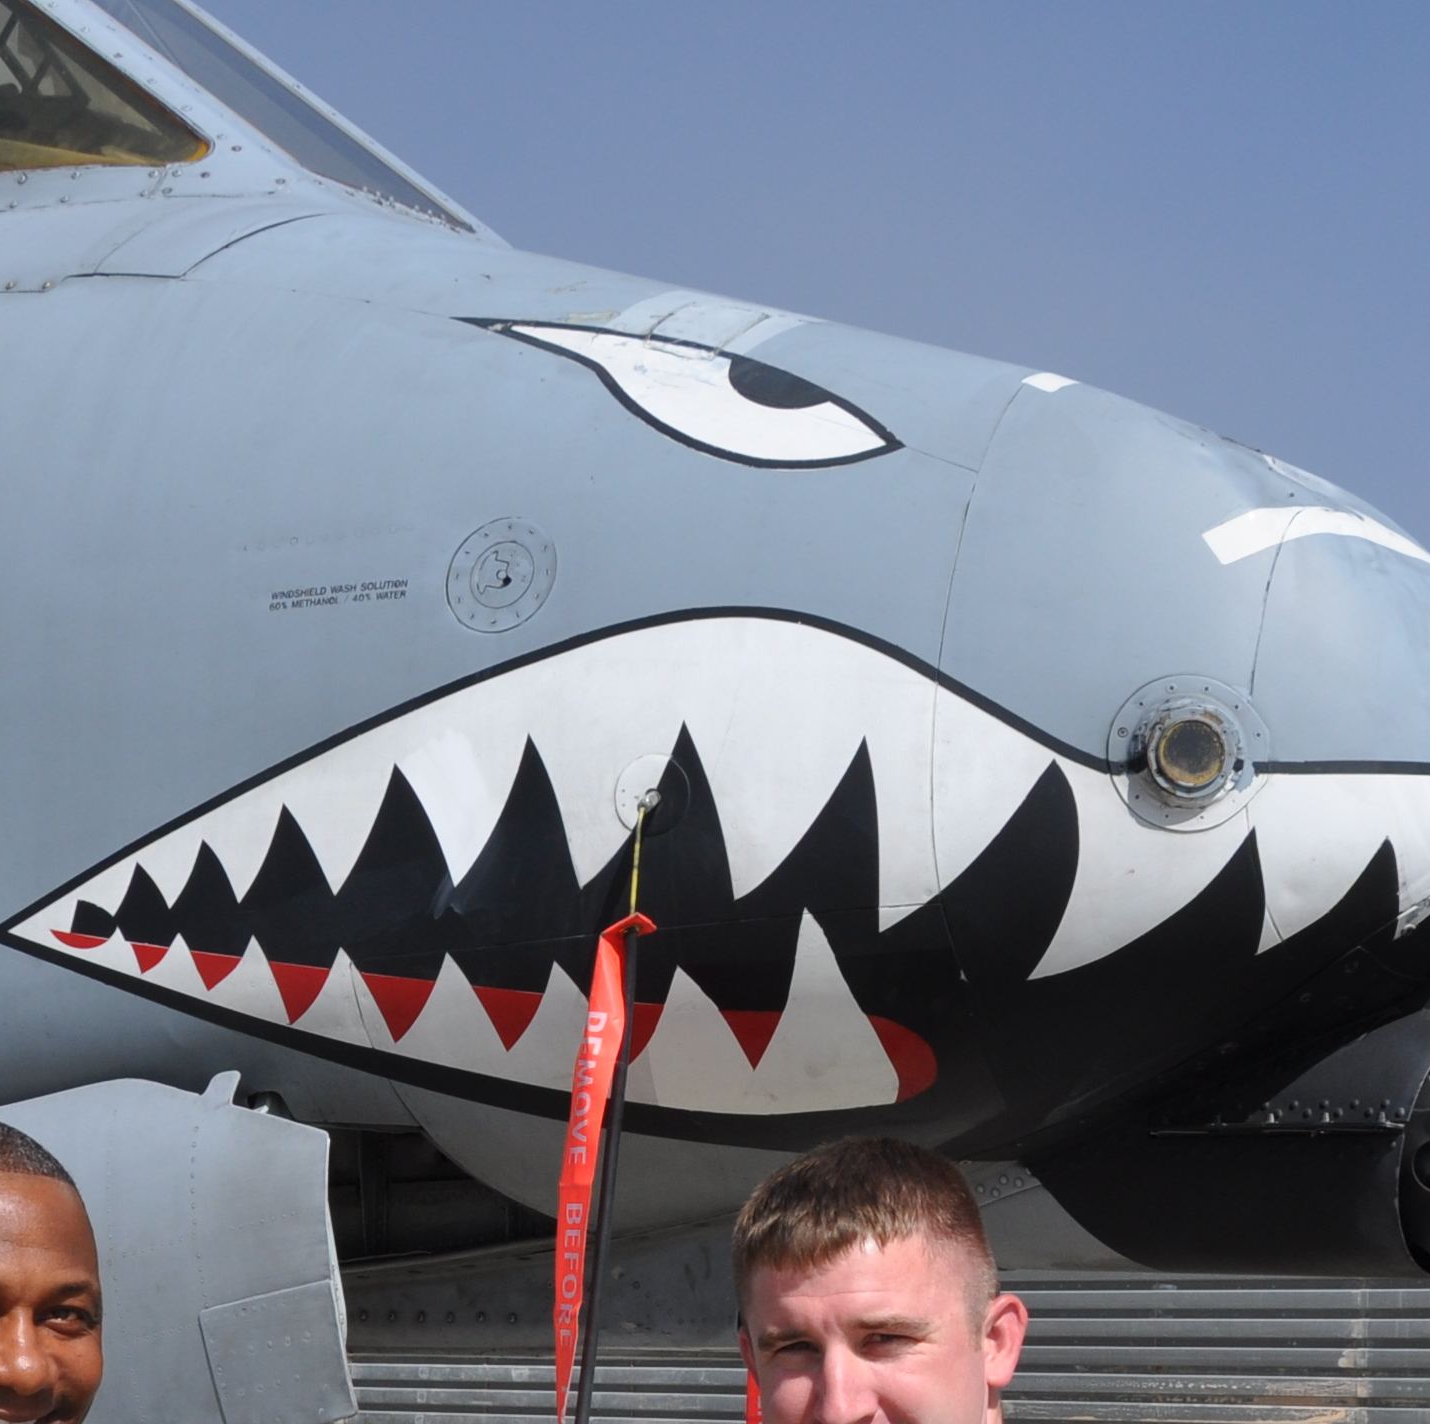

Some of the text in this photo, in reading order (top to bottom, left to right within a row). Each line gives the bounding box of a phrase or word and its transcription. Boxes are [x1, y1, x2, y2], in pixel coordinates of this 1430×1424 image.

[271, 579, 409, 600] WINDSHIELD WASH SOLUTION
[290, 596, 339, 609] METHANOL
[376, 590, 407, 601] WATER
[569, 1012, 607, 1165] REMOVE
[558, 1203, 583, 1348] BEFORE
